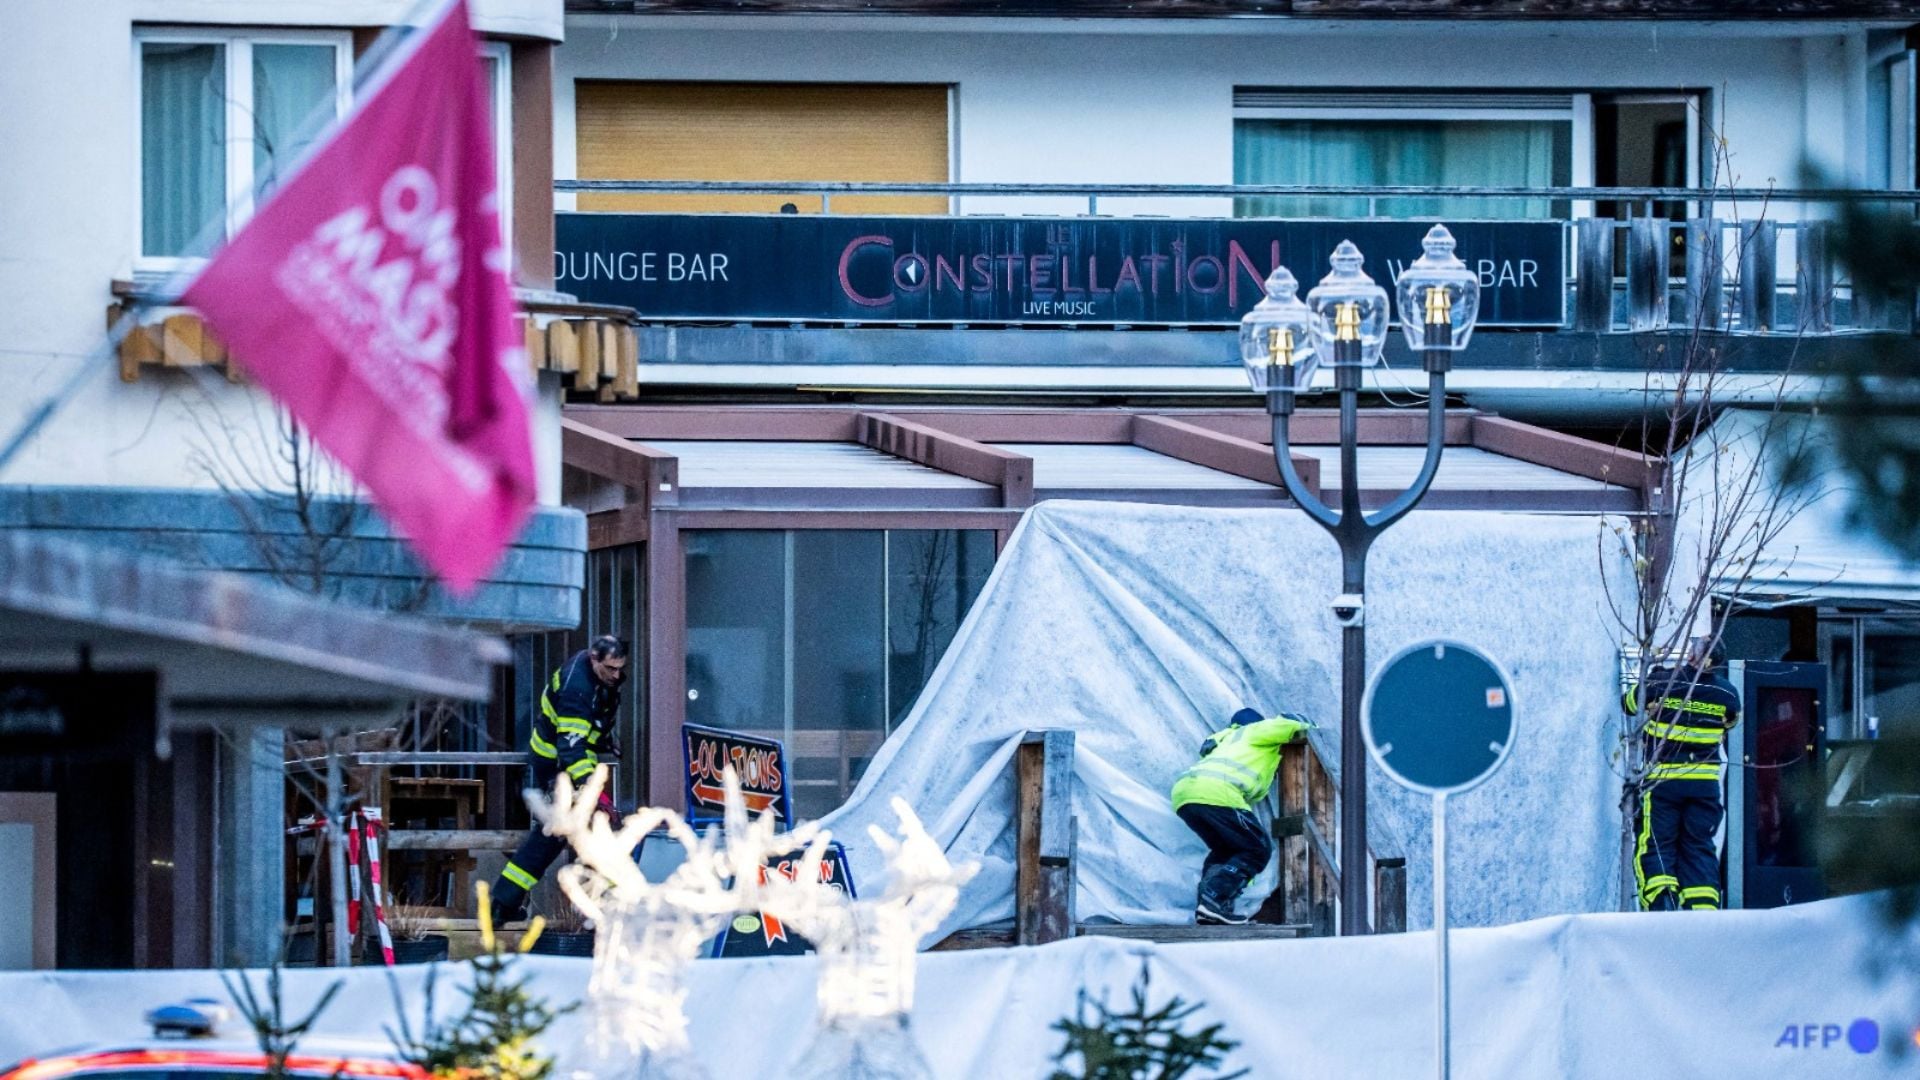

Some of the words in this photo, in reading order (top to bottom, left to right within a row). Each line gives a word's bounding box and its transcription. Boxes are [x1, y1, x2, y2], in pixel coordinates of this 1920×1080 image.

[553, 251, 657, 281] OUNGE
[668, 252, 729, 282] BAR
[838, 234, 1280, 309] CONSTELLATION
[1477, 259, 1539, 288] BAR
[1023, 301, 1051, 315] LIVE
[1054, 301, 1096, 315] MUSIC
